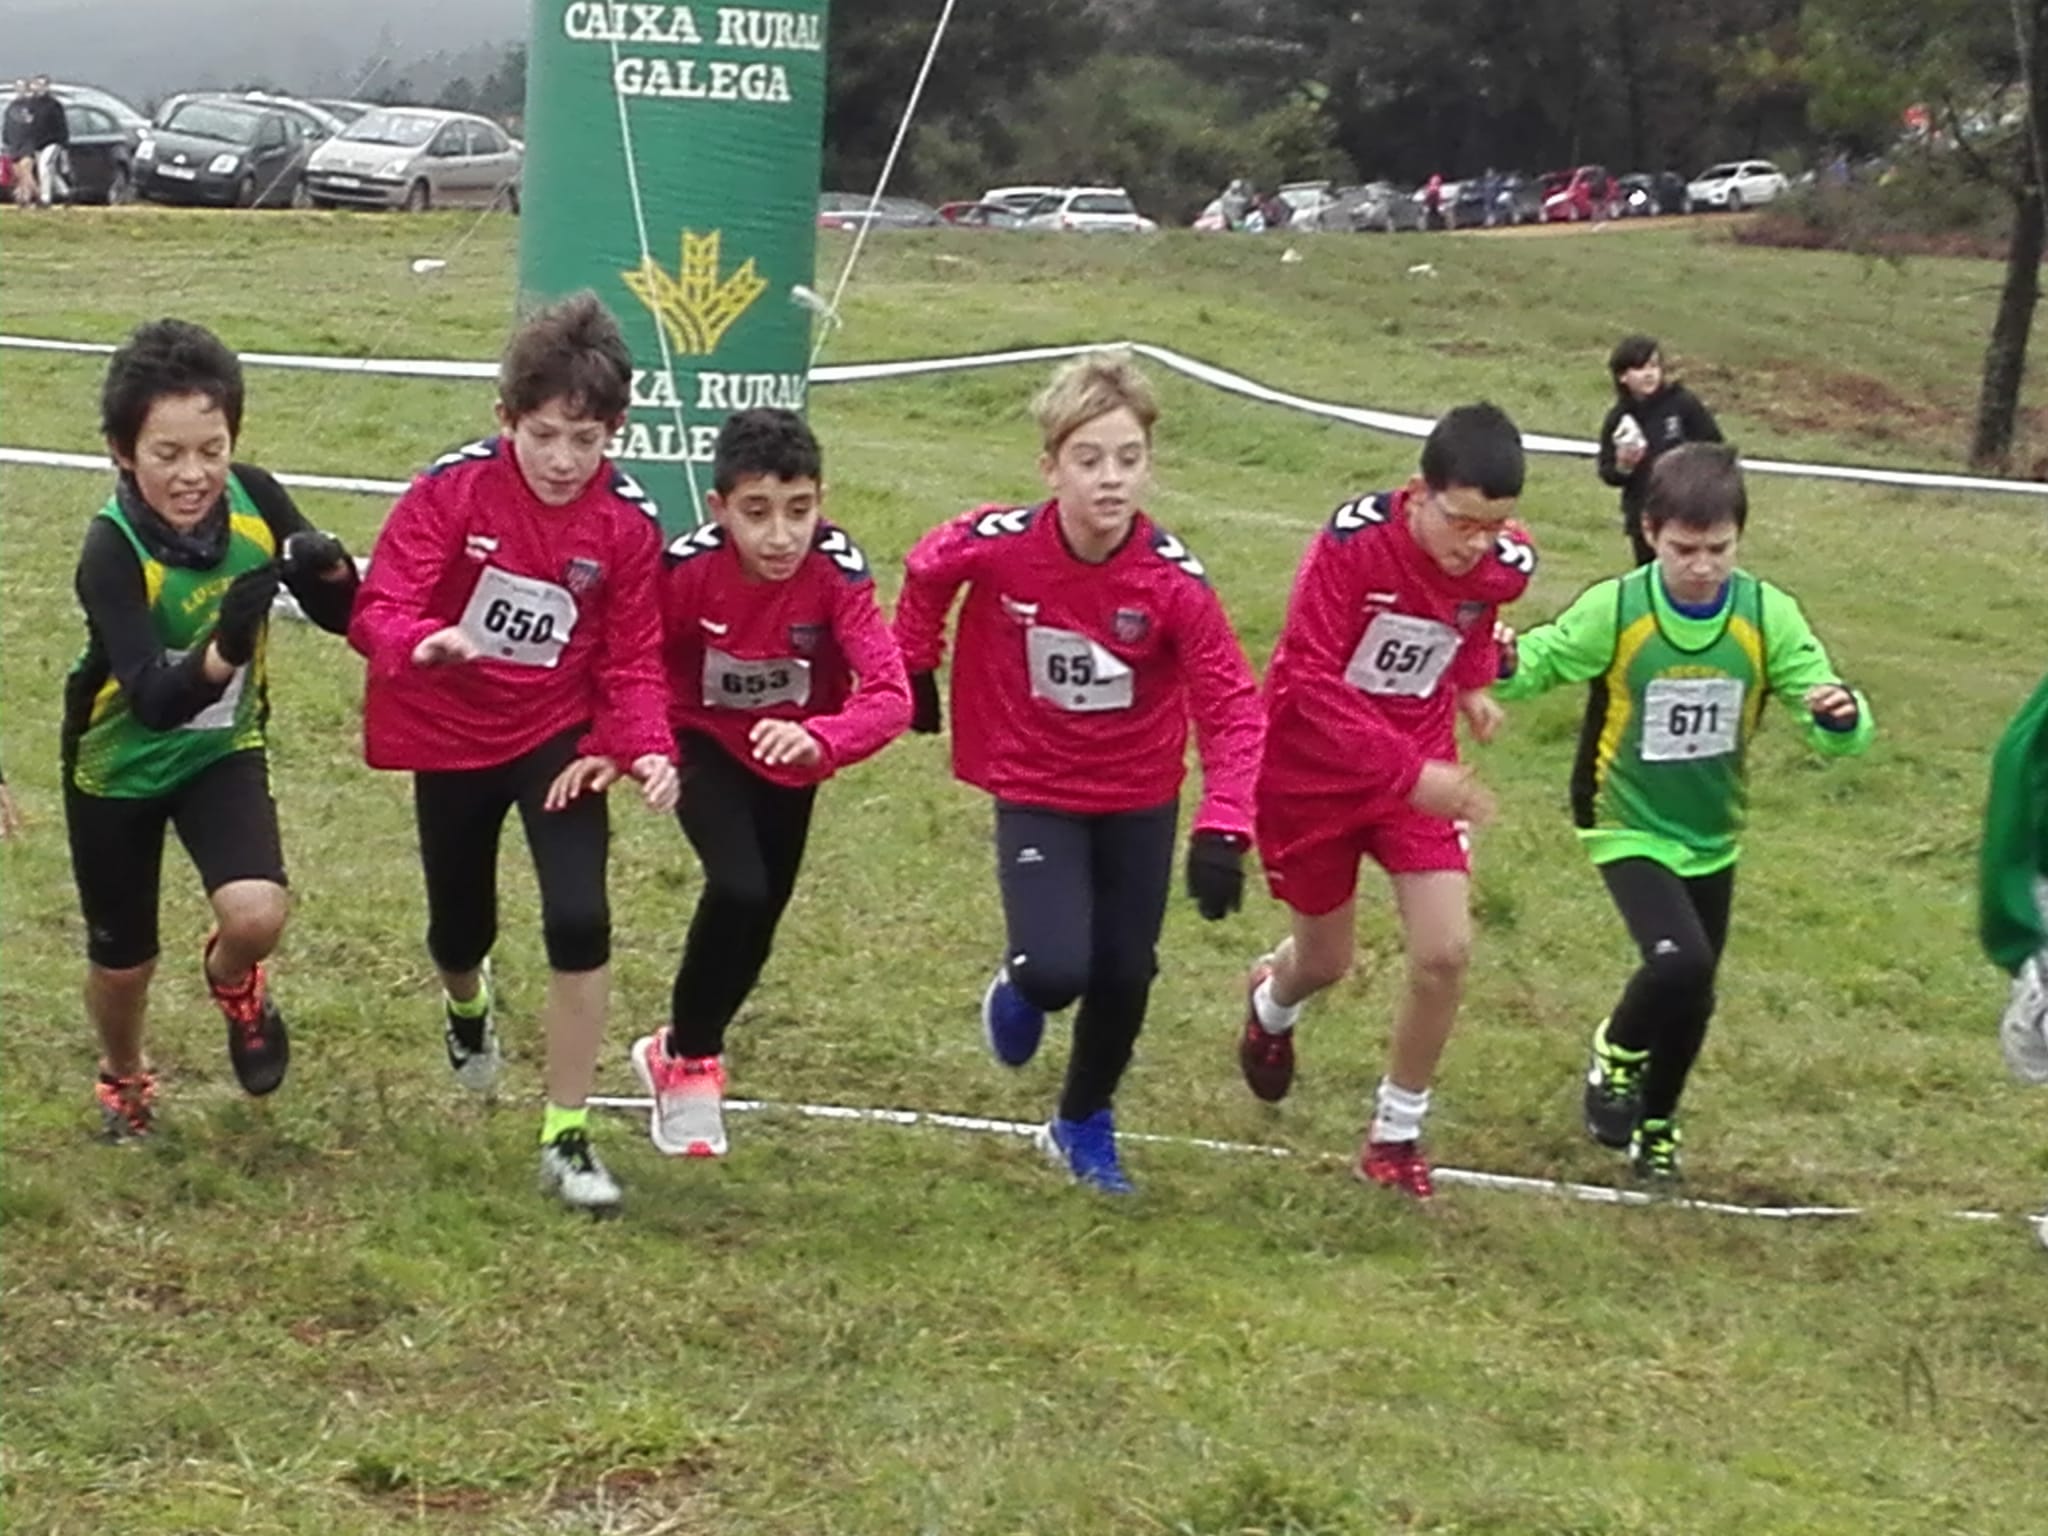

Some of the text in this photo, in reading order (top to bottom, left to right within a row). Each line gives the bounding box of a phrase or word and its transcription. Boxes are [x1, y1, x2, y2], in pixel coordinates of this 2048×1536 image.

[565, 2, 821, 49] CAIXA RURAL
[615, 58, 791, 101] GALEGA
[696, 371, 806, 410] RURAL
[484, 598, 555, 644] 650
[1048, 653, 1113, 686] 65
[1375, 639, 1435, 674] 651
[722, 669, 789, 694] 653
[1669, 702, 1719, 736] 671
